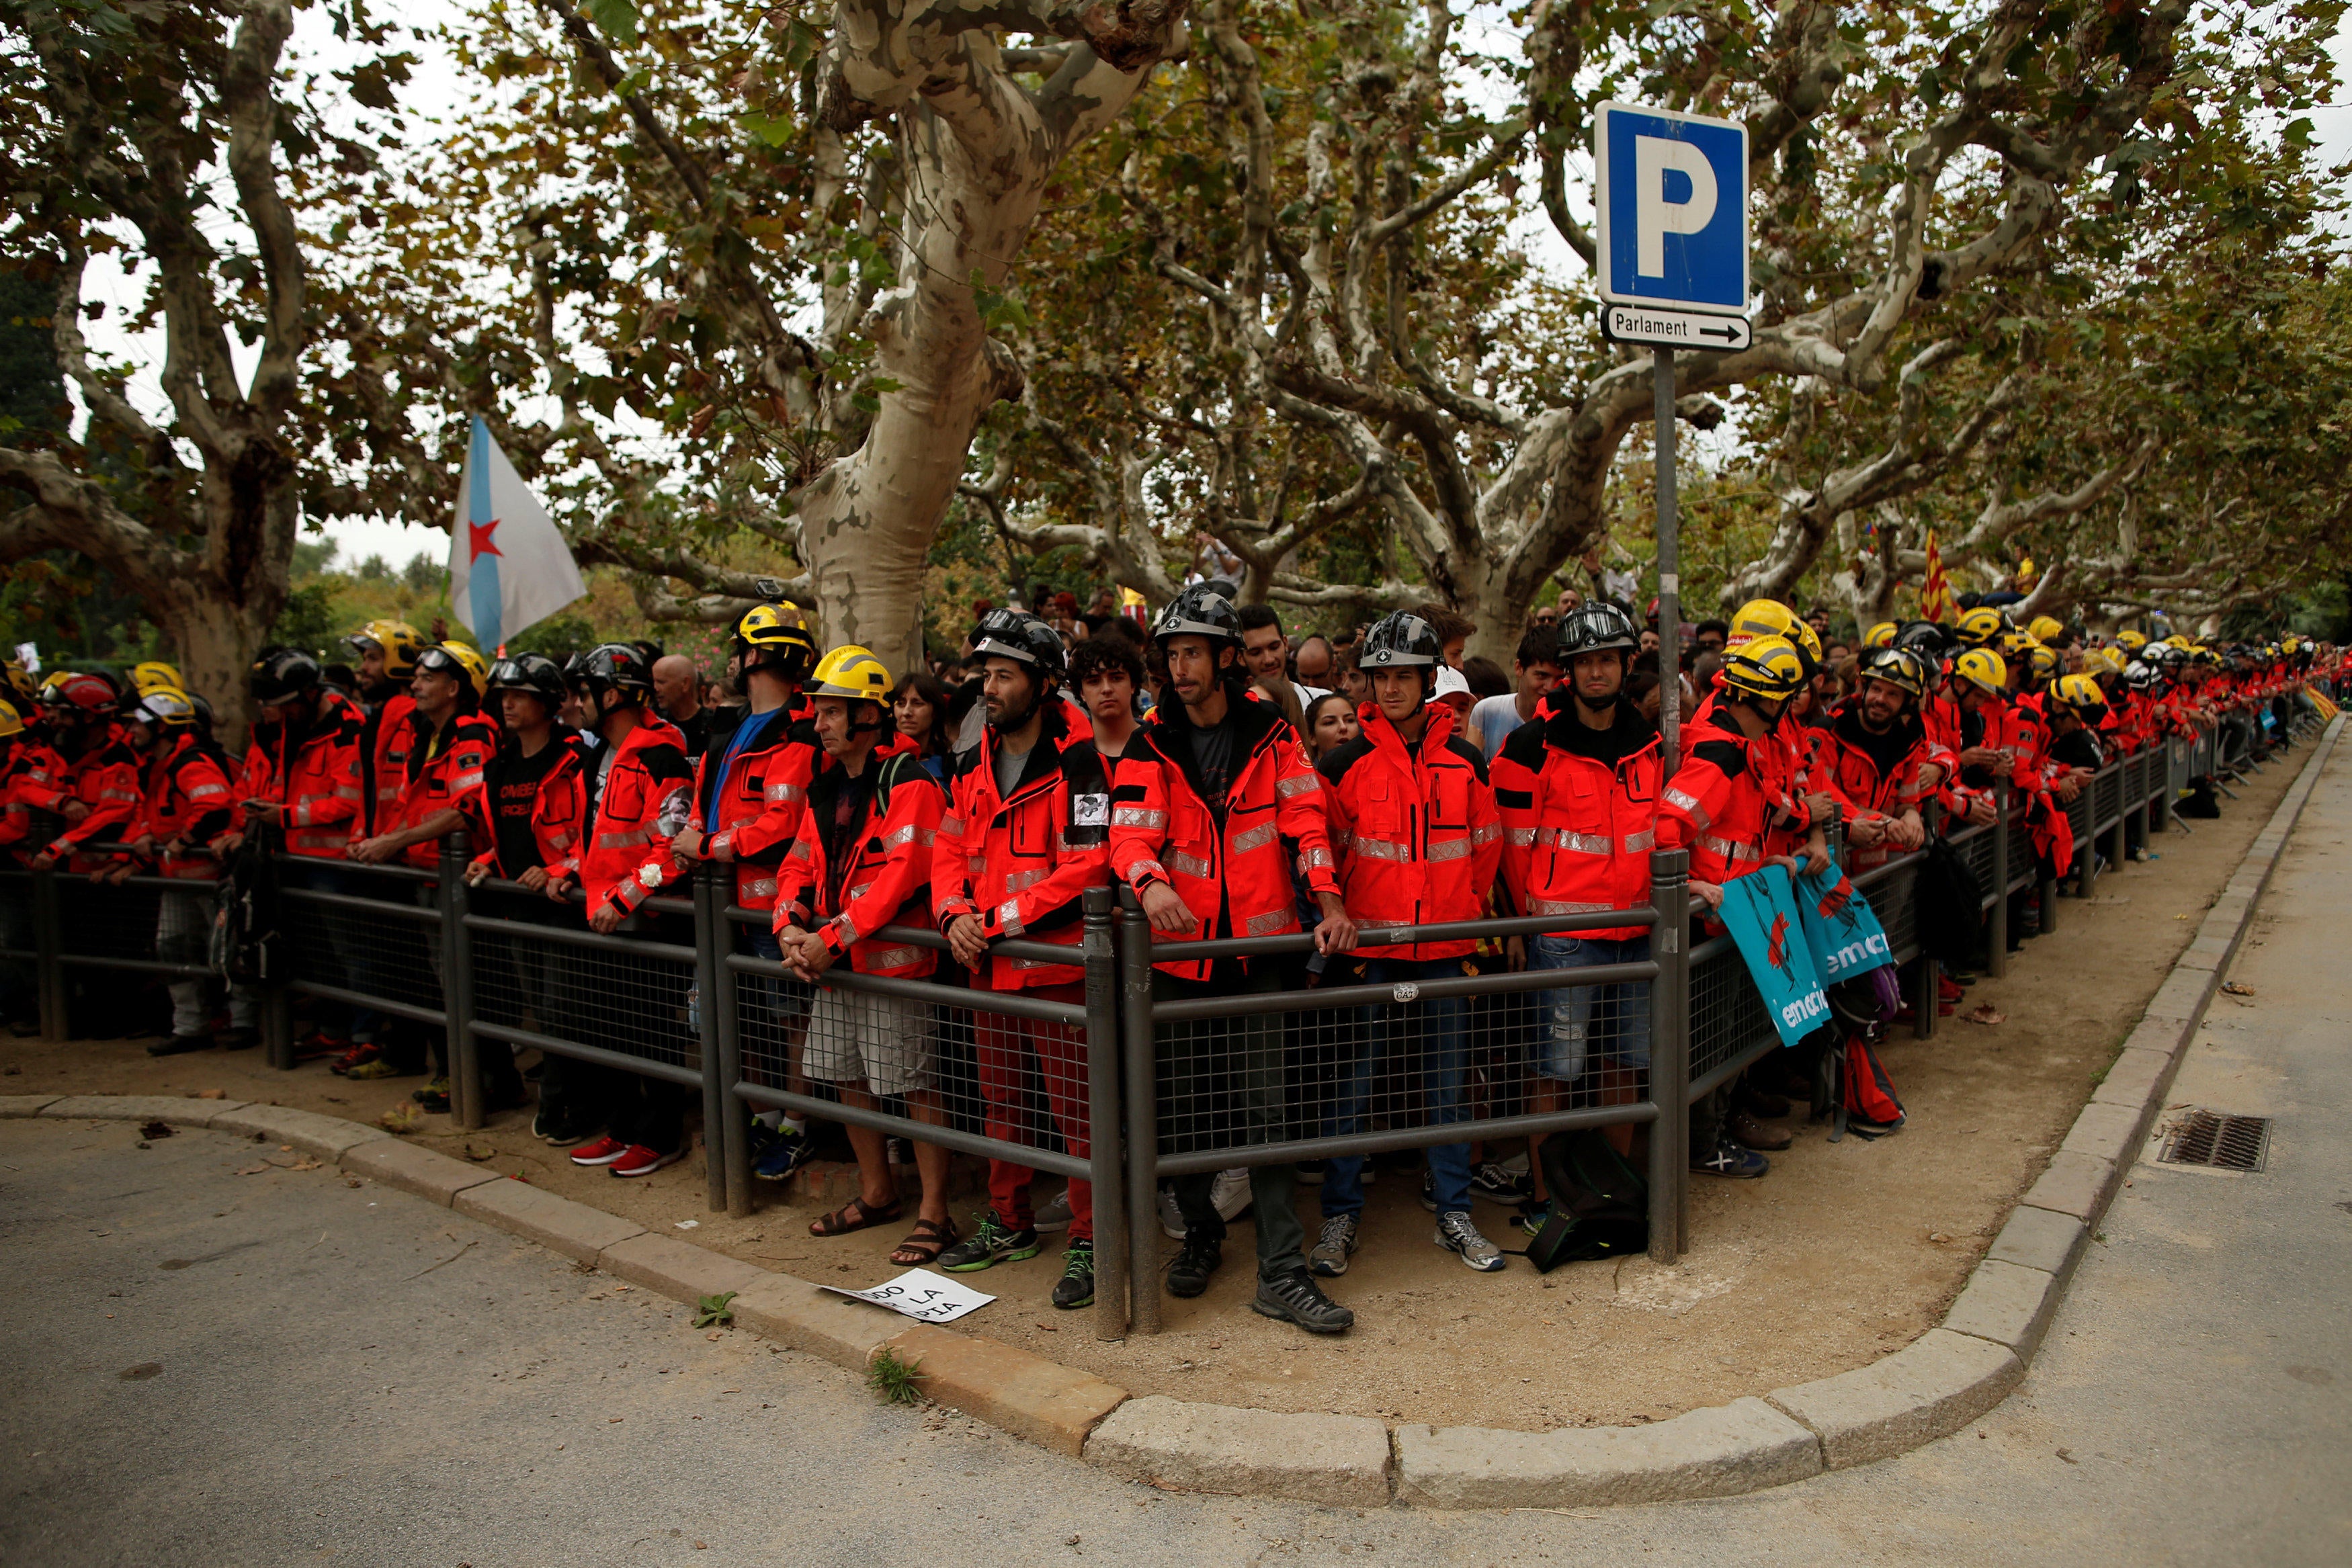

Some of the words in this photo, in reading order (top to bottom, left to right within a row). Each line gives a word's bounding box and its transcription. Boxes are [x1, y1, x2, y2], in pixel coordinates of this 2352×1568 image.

[1636, 134, 1718, 278] P
[1616, 312, 1687, 336] Parlament
[909, 1289, 944, 1304] LA
